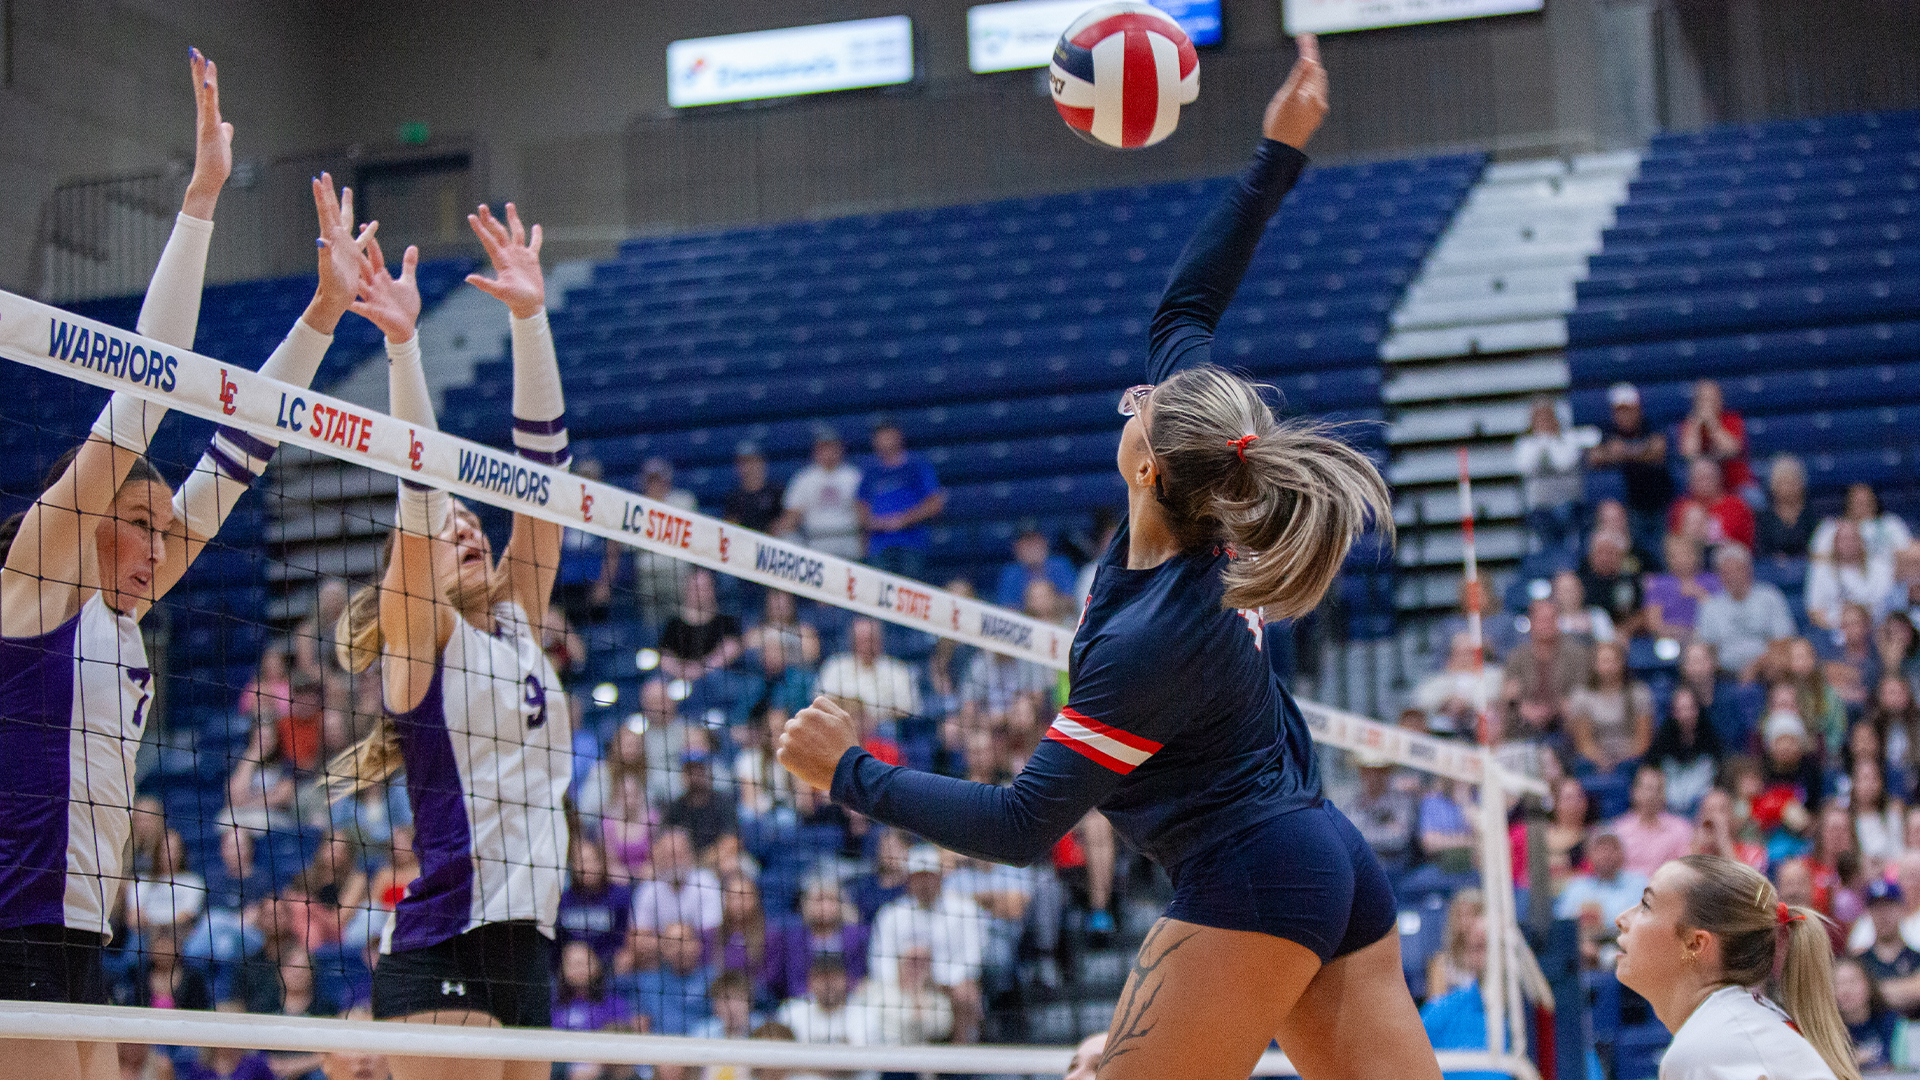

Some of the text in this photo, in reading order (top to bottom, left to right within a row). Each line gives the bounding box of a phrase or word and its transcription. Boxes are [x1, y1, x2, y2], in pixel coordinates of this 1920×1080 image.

[49, 317, 178, 393] WARRIORS
[276, 392, 306, 432] LC
[309, 403, 373, 453] STATE
[457, 448, 551, 507] WARRIORS
[621, 501, 644, 534] LC
[646, 509, 693, 549] STATE
[755, 541, 824, 589] WARRIORS
[896, 586, 932, 621] STATE
[126, 667, 151, 728] 7
[524, 674, 547, 730] 9
